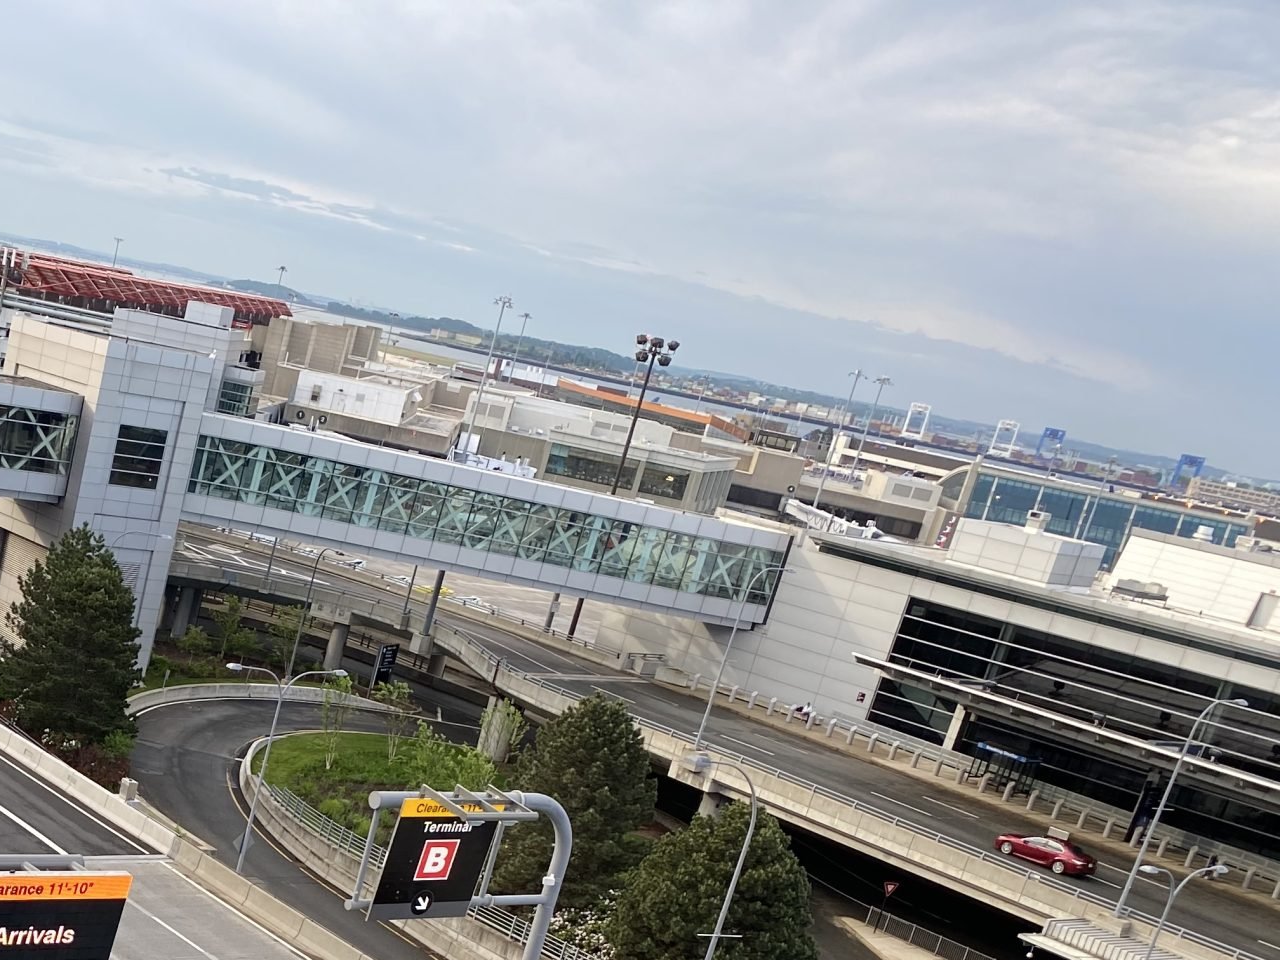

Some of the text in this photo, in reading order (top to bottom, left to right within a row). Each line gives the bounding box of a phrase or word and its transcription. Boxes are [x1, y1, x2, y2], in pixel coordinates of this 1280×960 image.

[423, 820, 473, 833] Terminal
[422, 846, 449, 874] B
[49, 882, 94, 895] 11'-10"
